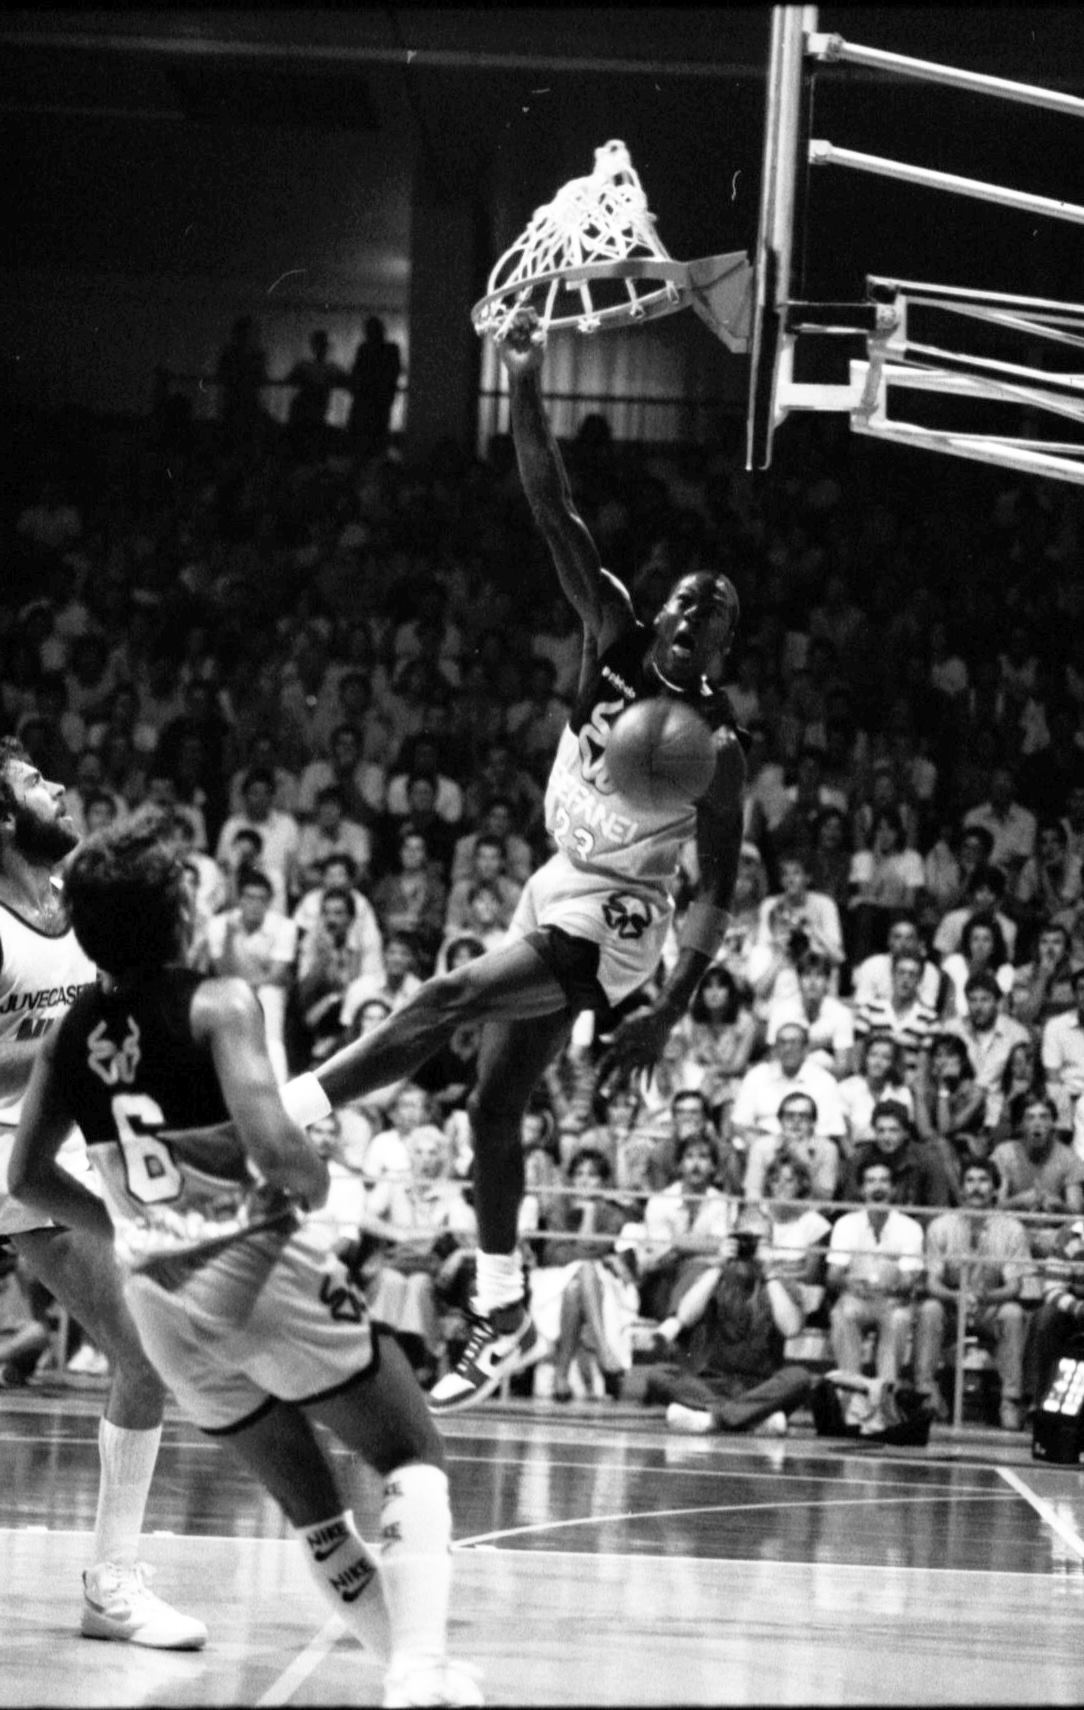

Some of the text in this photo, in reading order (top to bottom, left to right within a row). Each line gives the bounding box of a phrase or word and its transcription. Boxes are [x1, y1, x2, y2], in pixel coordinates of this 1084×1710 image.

[111, 1093, 182, 1203] 6
[306, 1521, 349, 1549] NIKE
[329, 1557, 377, 1592] NIKE
